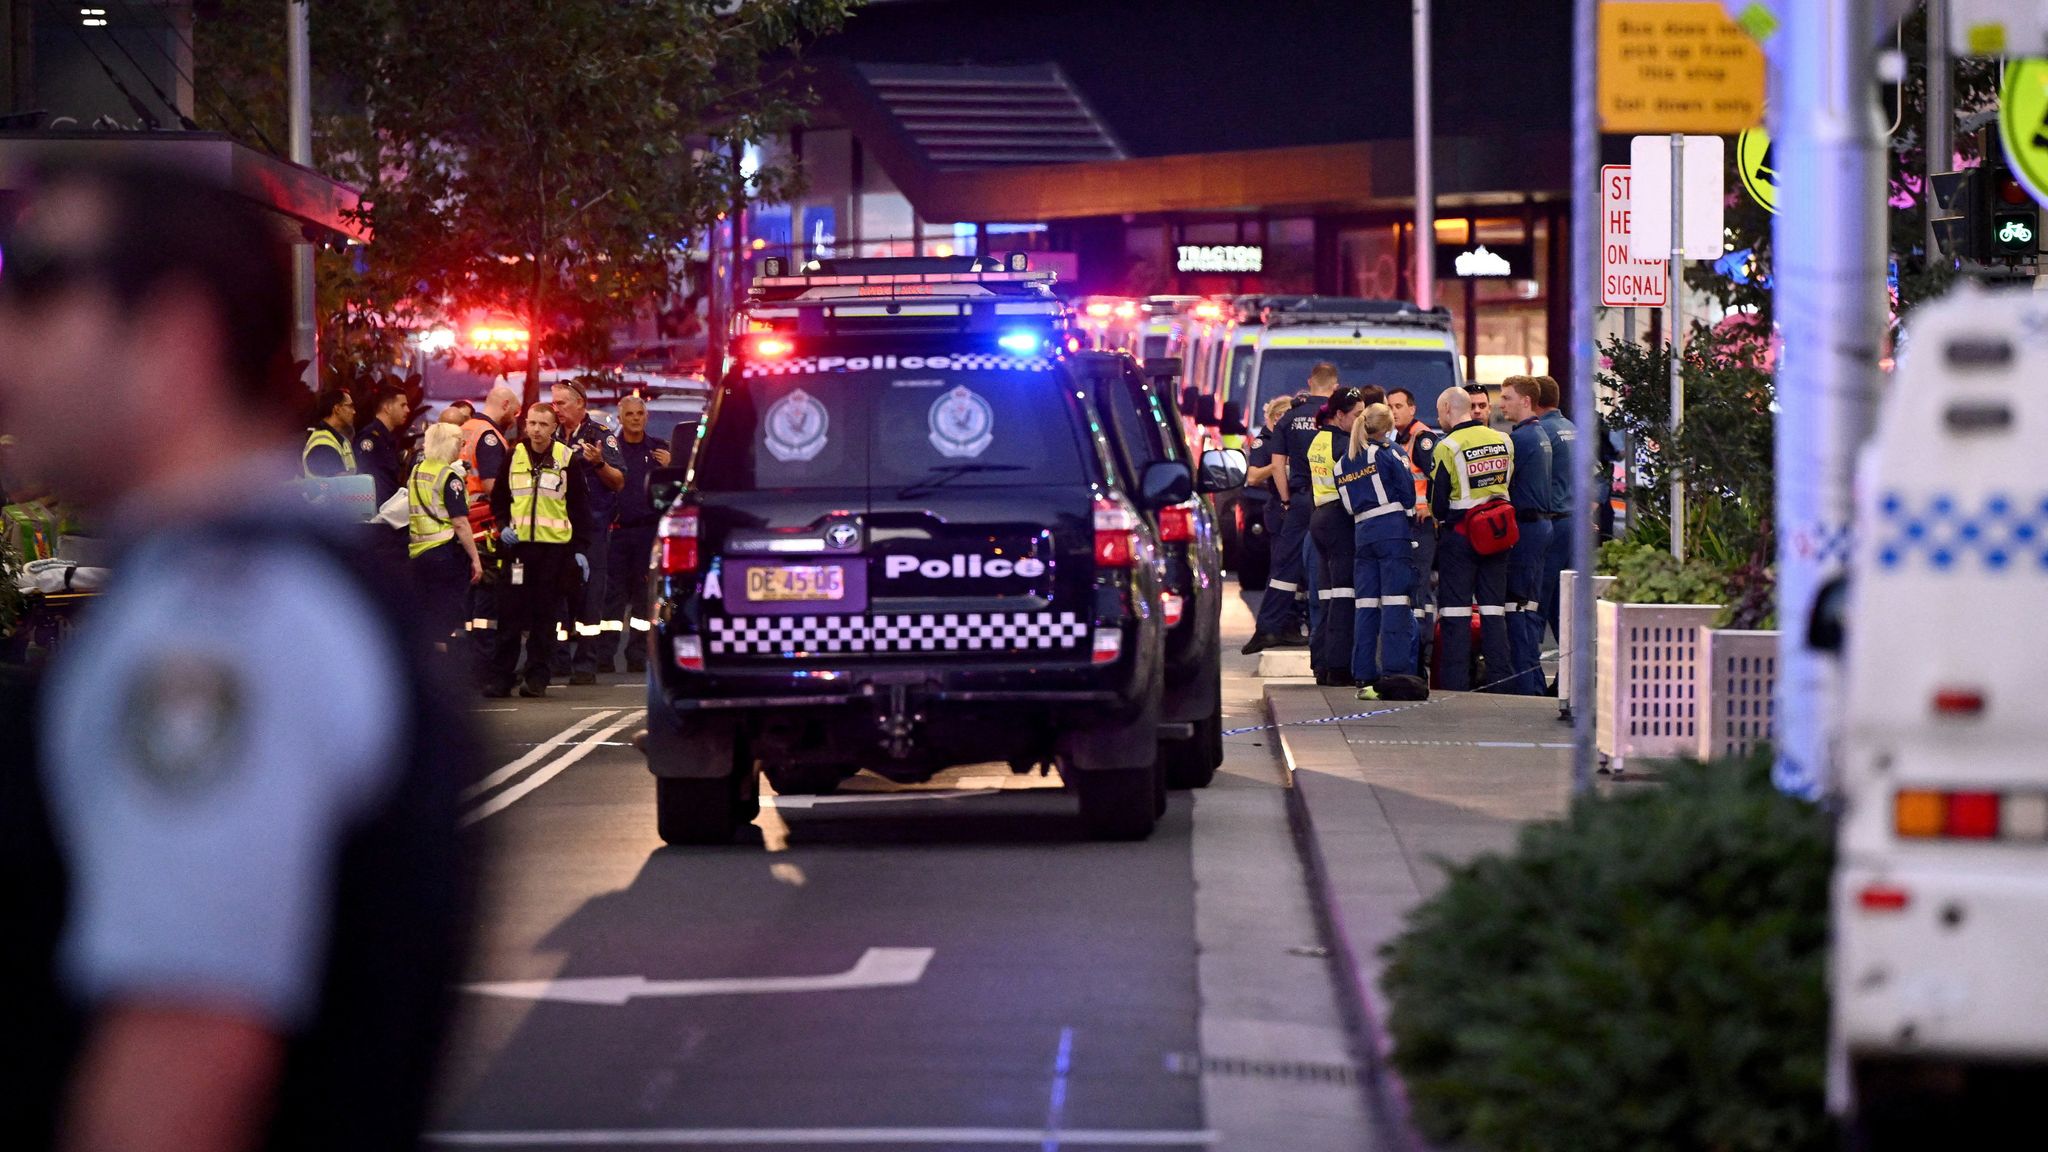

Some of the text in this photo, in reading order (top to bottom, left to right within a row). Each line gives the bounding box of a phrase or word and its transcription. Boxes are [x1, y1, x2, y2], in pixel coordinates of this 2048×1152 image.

[1611, 176, 1631, 200] ST
[1610, 210, 1631, 234] HE
[1607, 244, 1628, 265] ON
[1607, 275, 1662, 296] SIGNAL
[818, 355, 951, 372] Police
[1338, 463, 1377, 485] AMBULANCE
[1469, 458, 1508, 474] DOCTOR
[885, 553, 1045, 579] Police
